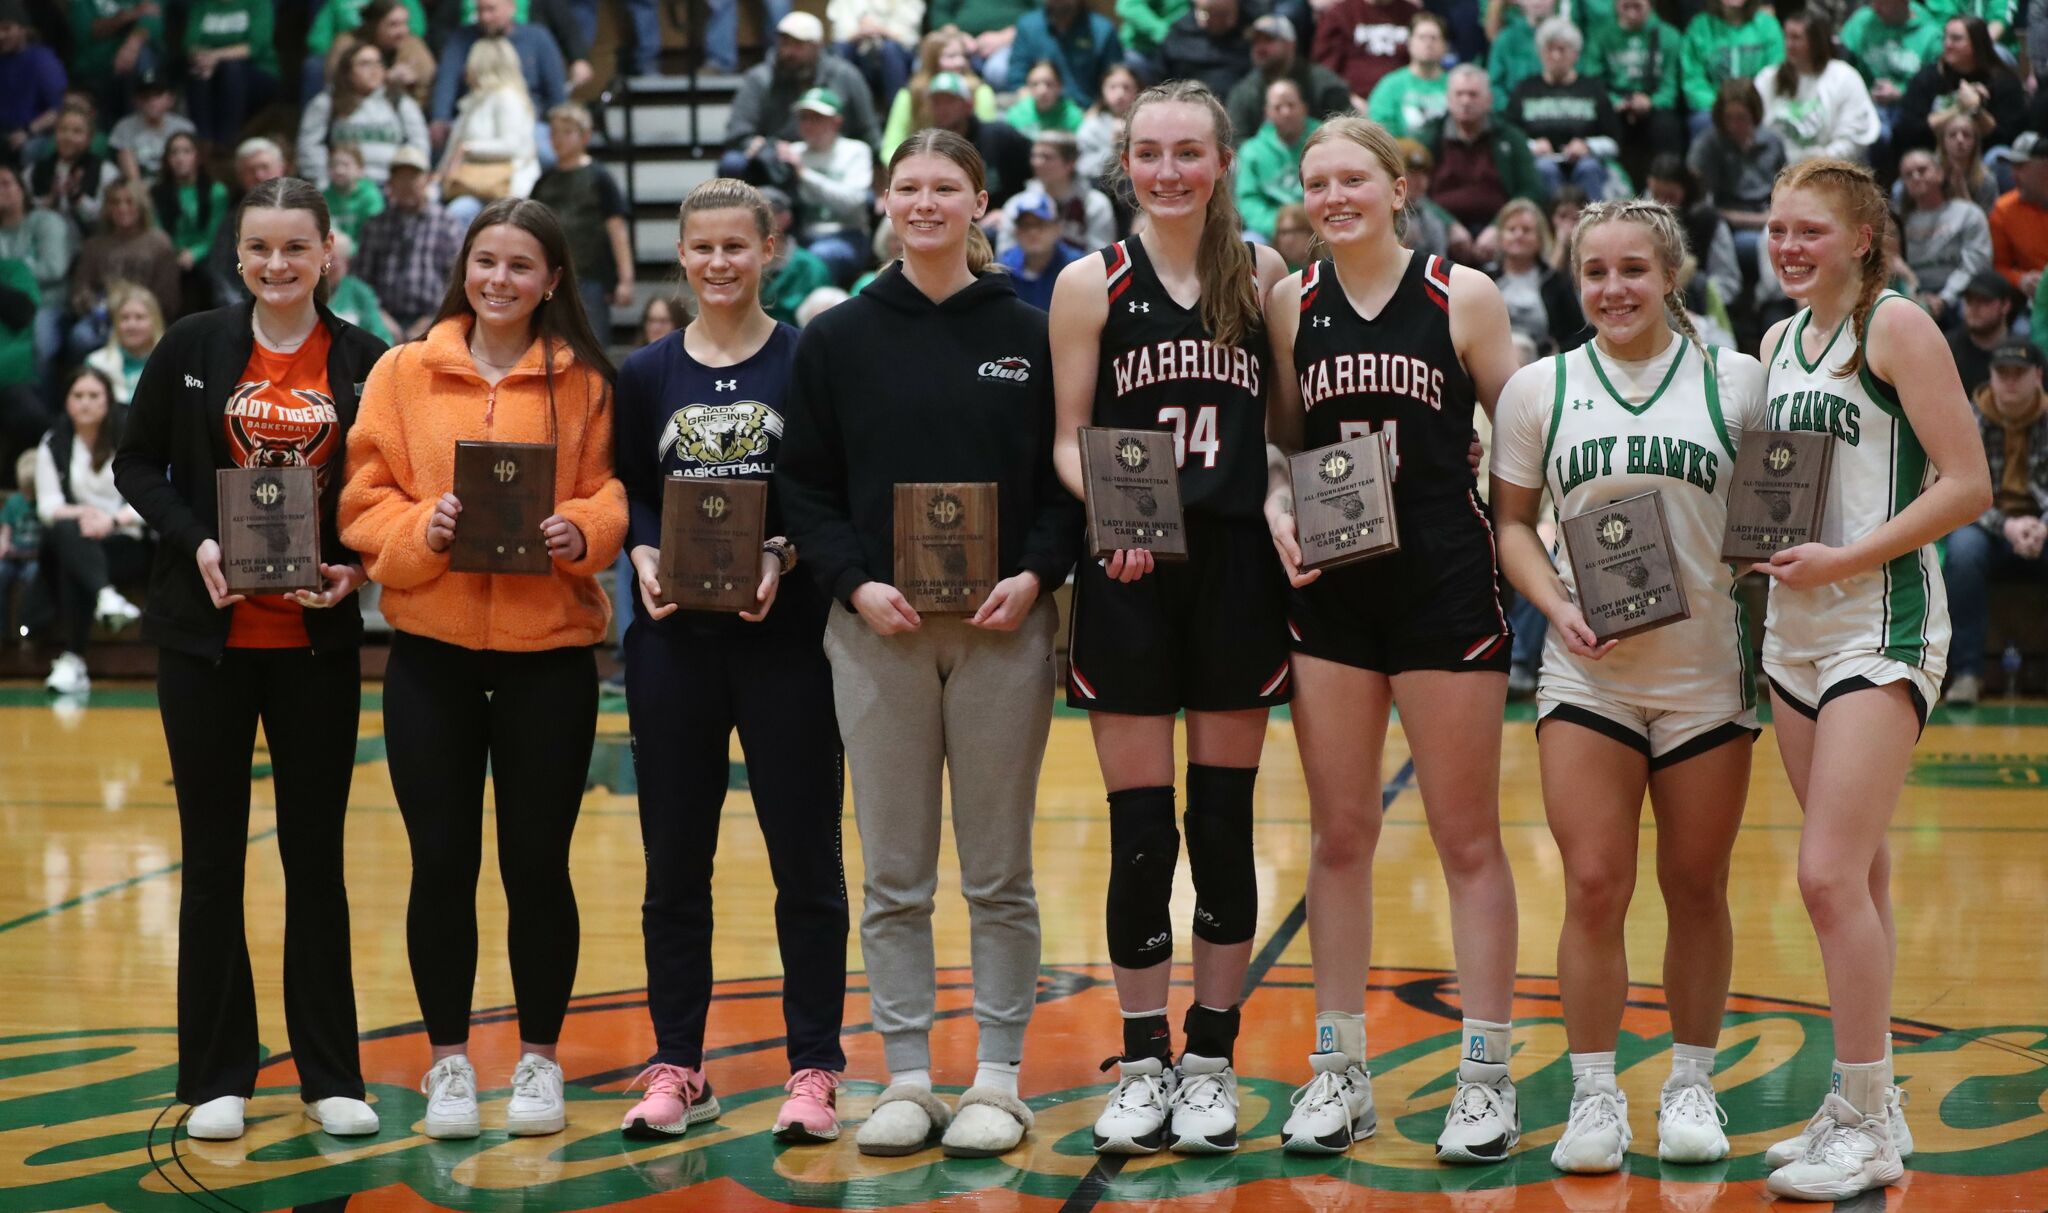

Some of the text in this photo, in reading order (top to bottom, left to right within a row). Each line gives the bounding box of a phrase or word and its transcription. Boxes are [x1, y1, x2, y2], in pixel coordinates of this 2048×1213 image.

[978, 361, 1029, 382] Club
[1113, 339, 1260, 397] WARRIORS
[1300, 353, 1444, 412] WARRIORS
[224, 397, 338, 423] LADY TIGERS
[687, 413, 750, 426] GRIFFINS
[703, 406, 736, 415] LADY
[1789, 390, 1860, 447] HAWKS
[246, 420, 314, 433] BASKETBALL
[1158, 405, 1220, 469] 34
[1121, 444, 1141, 466] 49
[1769, 447, 1790, 470] 49
[494, 460, 516, 482] 49
[1325, 456, 1346, 478] 49
[1556, 435, 1719, 498] LADY HAWKS
[256, 483, 279, 504] 49
[1303, 478, 1375, 502] ALL-TOURNAMENT TEAM
[702, 495, 724, 518] 49
[934, 501, 956, 523] 49
[1102, 519, 1178, 530] LADY HAWK INVITE
[1114, 528, 1169, 537] CARROLLTON
[1304, 516, 1385, 544] LADY HAWK INVITE
[1602, 520, 1624, 543] 49
[1731, 525, 1807, 536] LADY HAWK INVITE
[1317, 527, 1374, 548] CARROLLTON
[1335, 539, 1357, 550] 2024
[1740, 534, 1795, 543] CARROLLTON
[230, 558, 253, 566] LADY
[1585, 543, 1656, 569] ALL-TOURNAMENT TEAM
[1590, 584, 1672, 616] LADY HAWK INVITE
[1604, 595, 1662, 619] CARROLLTON
[1623, 609, 1646, 621] 2024
